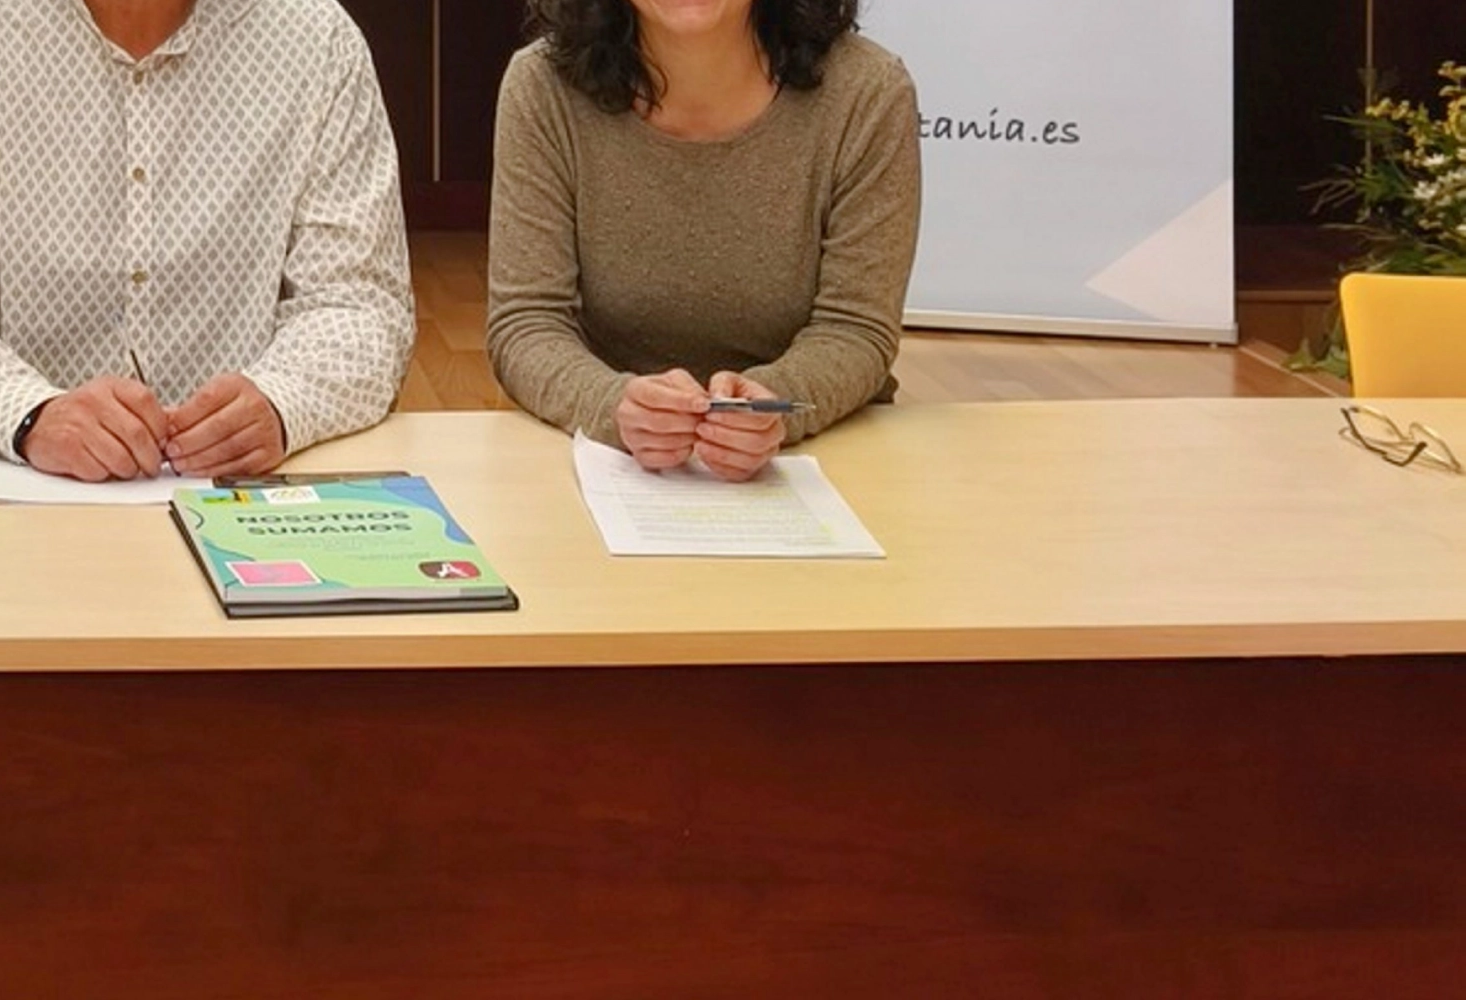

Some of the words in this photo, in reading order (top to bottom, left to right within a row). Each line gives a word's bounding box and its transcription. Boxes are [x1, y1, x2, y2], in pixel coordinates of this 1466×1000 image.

[916, 107, 1080, 144] tanía.es
[236, 511, 410, 524] NOSOTROS
[247, 523, 412, 536] SUMAMOS
